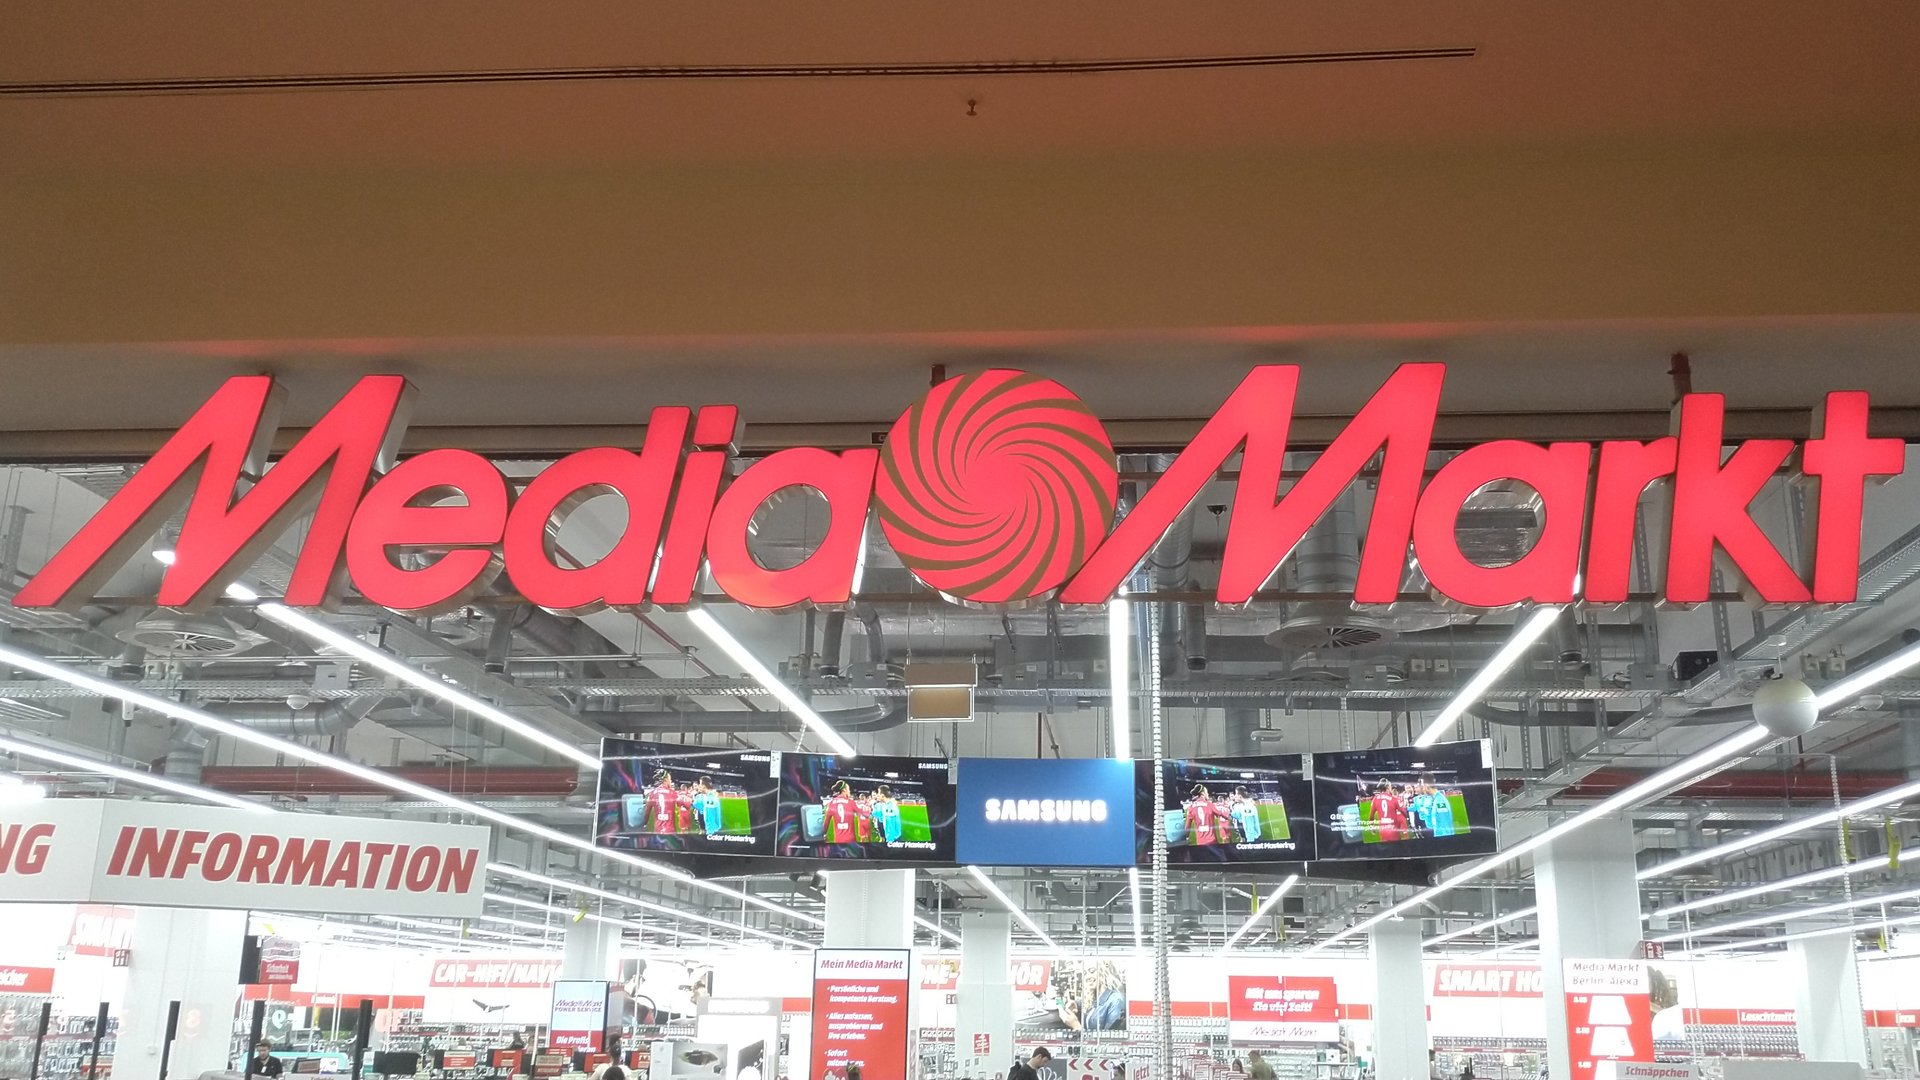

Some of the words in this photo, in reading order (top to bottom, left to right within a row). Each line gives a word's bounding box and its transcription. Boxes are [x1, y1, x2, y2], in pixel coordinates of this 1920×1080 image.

[12, 374, 880, 609] Media
[1058, 361, 1906, 607] Markt
[985, 798, 1107, 822] SAMSUNG
[724, 834, 756, 844] Mastering
[904, 841, 936, 850] Mastering
[1236, 842, 1263, 850] Contrast
[1263, 842, 1296, 850] Mastering
[106, 826, 479, 894] INFORMATION
[821, 959, 844, 969] Mein
[845, 959, 873, 969] Media
[875, 959, 903, 969] Markt
[1572, 962, 1605, 972] Media
[1607, 962, 1640, 972] Markt
[1439, 969, 1514, 992] SMART
[1572, 976, 1604, 986] Berlin
[1610, 977, 1639, 986] Alexa
[830, 985, 865, 993] Persönliche
[866, 985, 879, 993] und
[1252, 1001, 1268, 1012] Sie
[828, 1023, 869, 1031] ausprobieren
[556, 1036, 568, 1044] Die
[827, 1049, 848, 1057] Sofort
[1625, 1066, 1690, 1079] Schnäppchen
